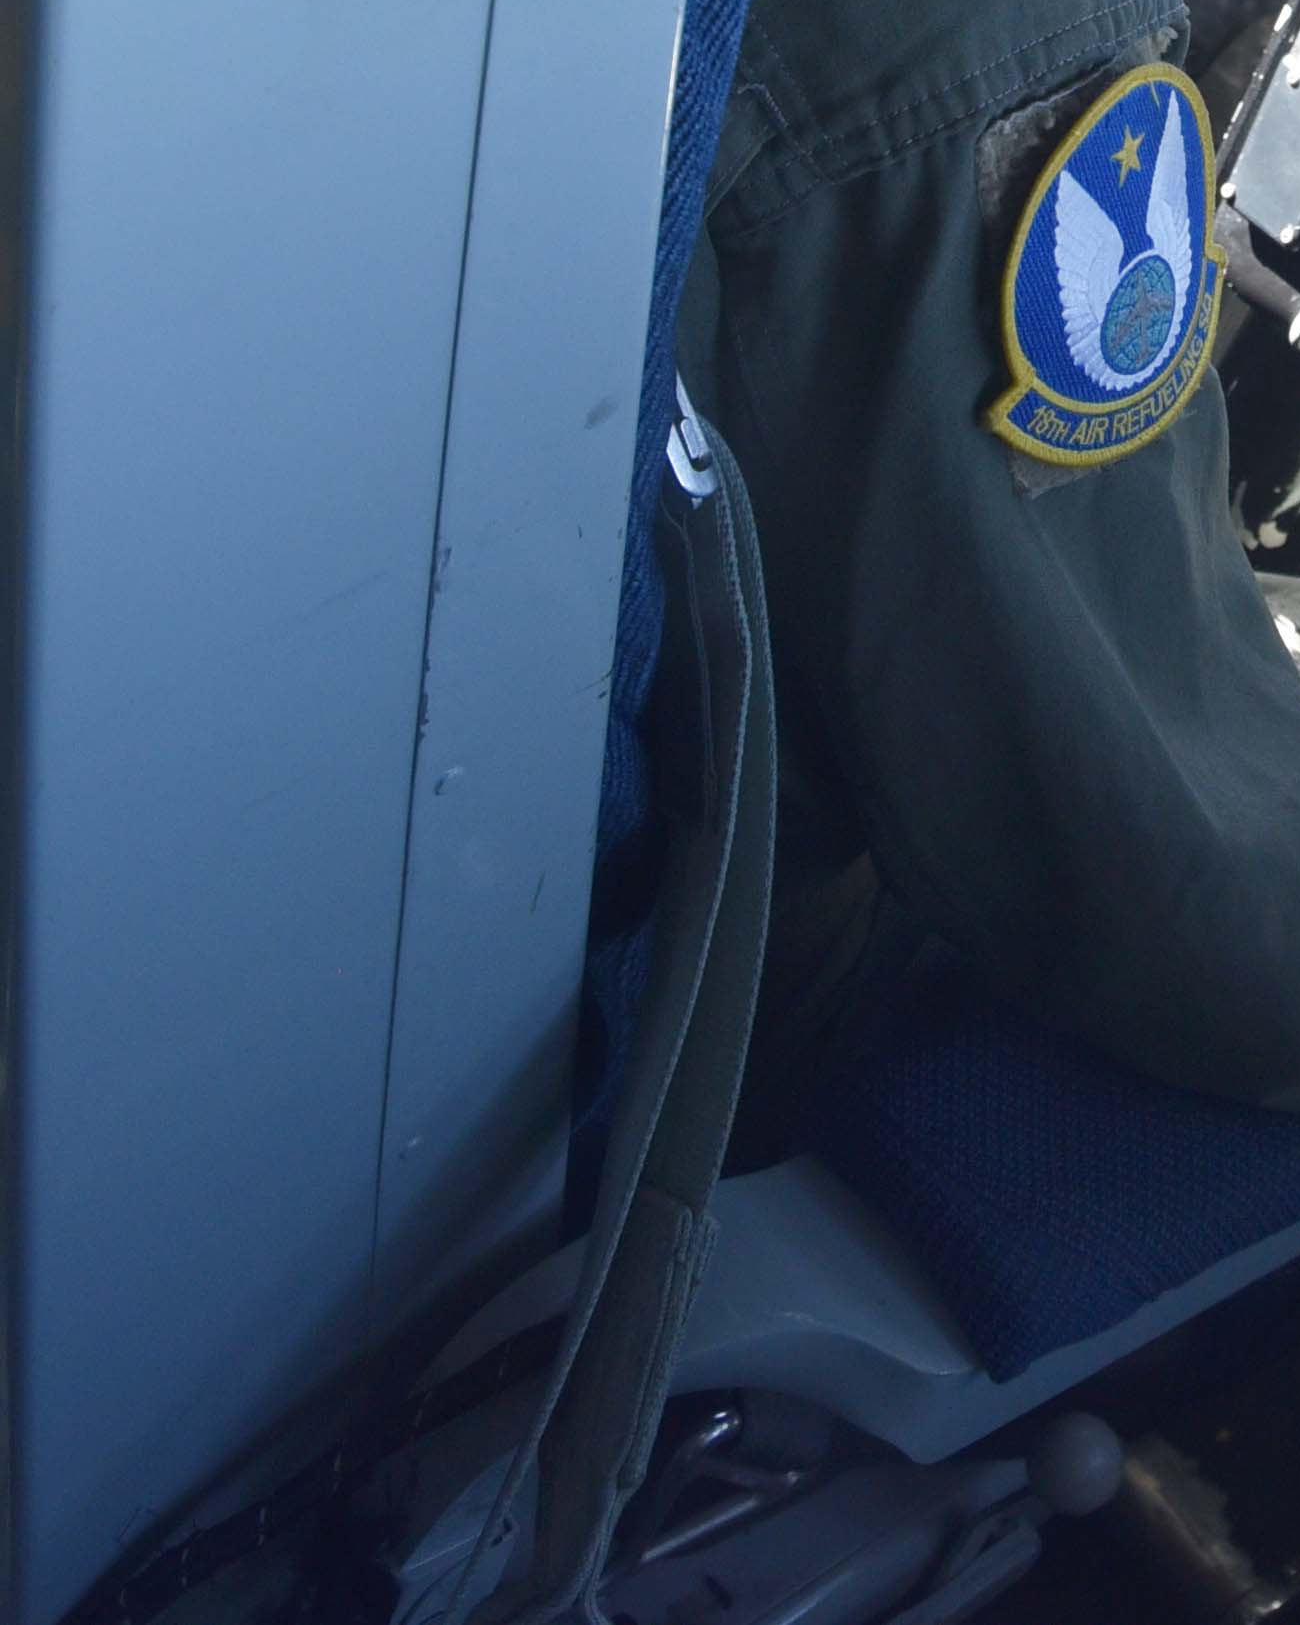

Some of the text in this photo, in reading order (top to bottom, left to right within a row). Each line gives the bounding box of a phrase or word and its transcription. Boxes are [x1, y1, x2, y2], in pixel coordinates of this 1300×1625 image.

[1027, 405, 1071, 443] 18TH
[1069, 417, 1109, 445] AIR
[1111, 340, 1204, 442] REFUELING
